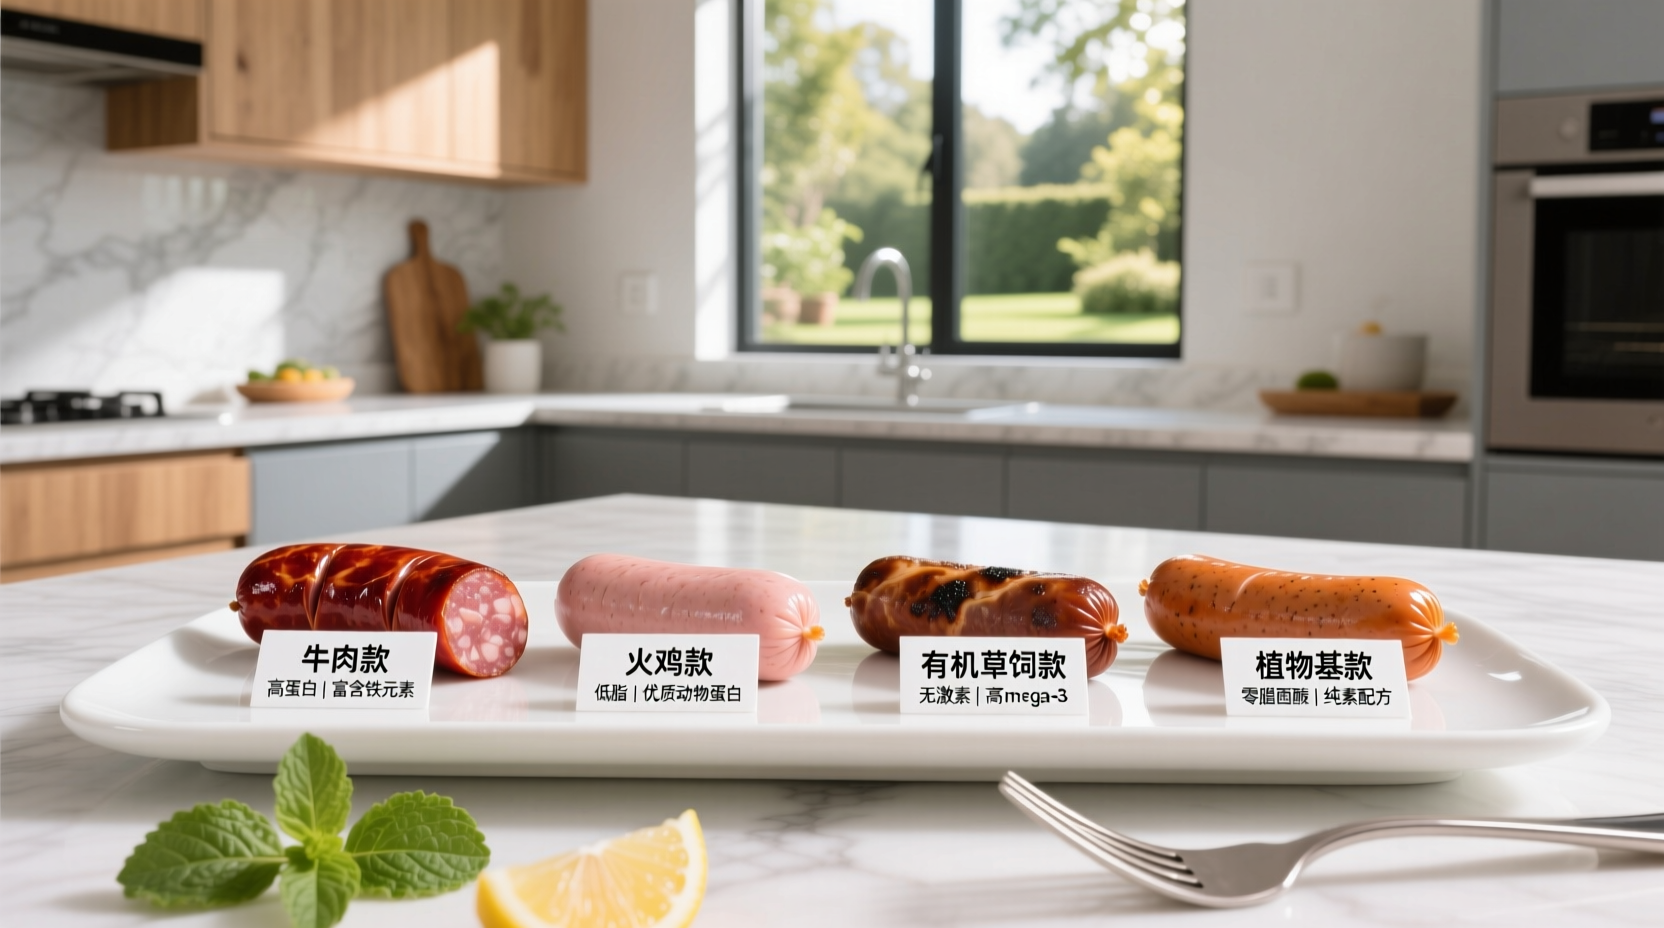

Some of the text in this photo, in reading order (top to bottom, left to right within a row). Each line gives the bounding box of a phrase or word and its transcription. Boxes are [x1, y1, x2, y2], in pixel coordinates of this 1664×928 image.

[301, 643, 390, 674] 牛肉款
[625, 645, 714, 678] 火鸡款
[921, 648, 1067, 681] 有机草饲款
[1255, 649, 1373, 681] 植物基款
[267, 678, 317, 700] 高蛋白
[331, 679, 415, 701] 富含铁元素
[594, 681, 628, 703] 低脂
[642, 682, 741, 704] 优质动物蛋白
[919, 685, 972, 707] 无激素
[1323, 684, 1393, 708] 纯素配方
